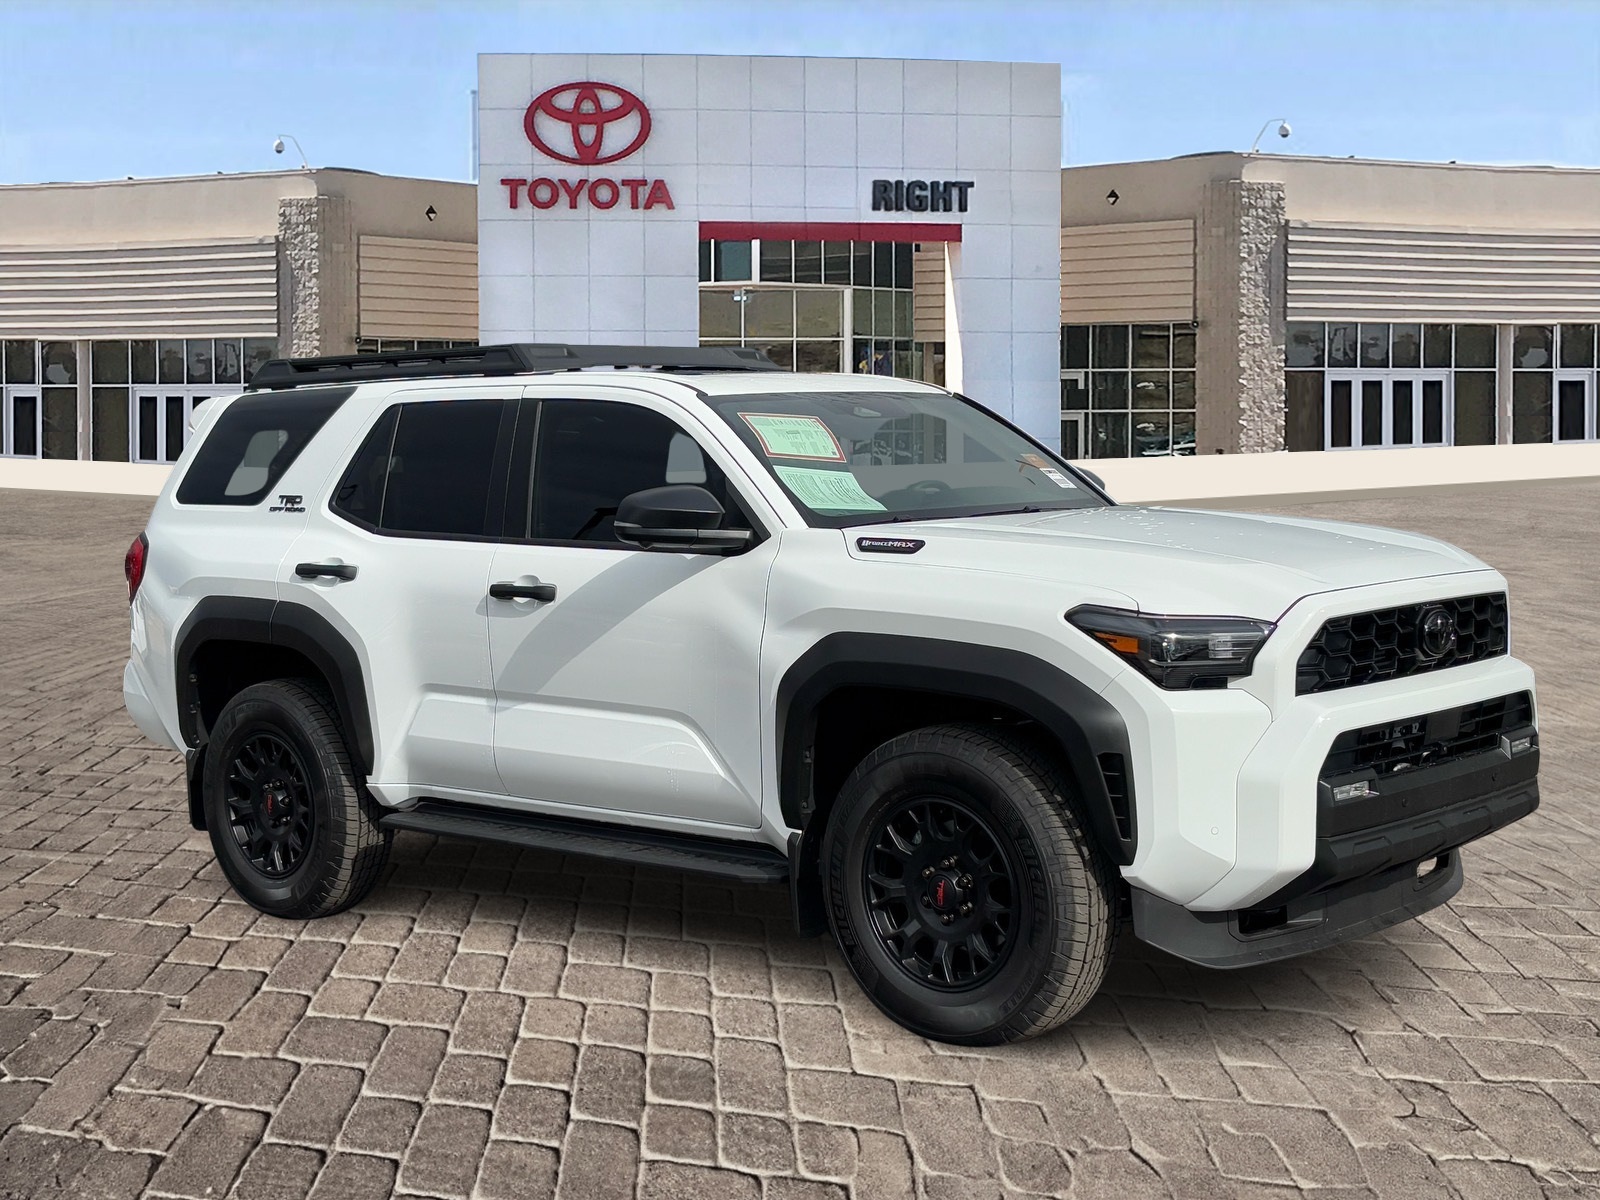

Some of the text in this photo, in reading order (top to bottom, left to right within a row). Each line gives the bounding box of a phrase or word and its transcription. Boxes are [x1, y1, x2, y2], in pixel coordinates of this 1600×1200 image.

[500, 177, 675, 210] TOYOTA
[871, 179, 975, 212] RIGHT
[279, 495, 303, 506] TRD
